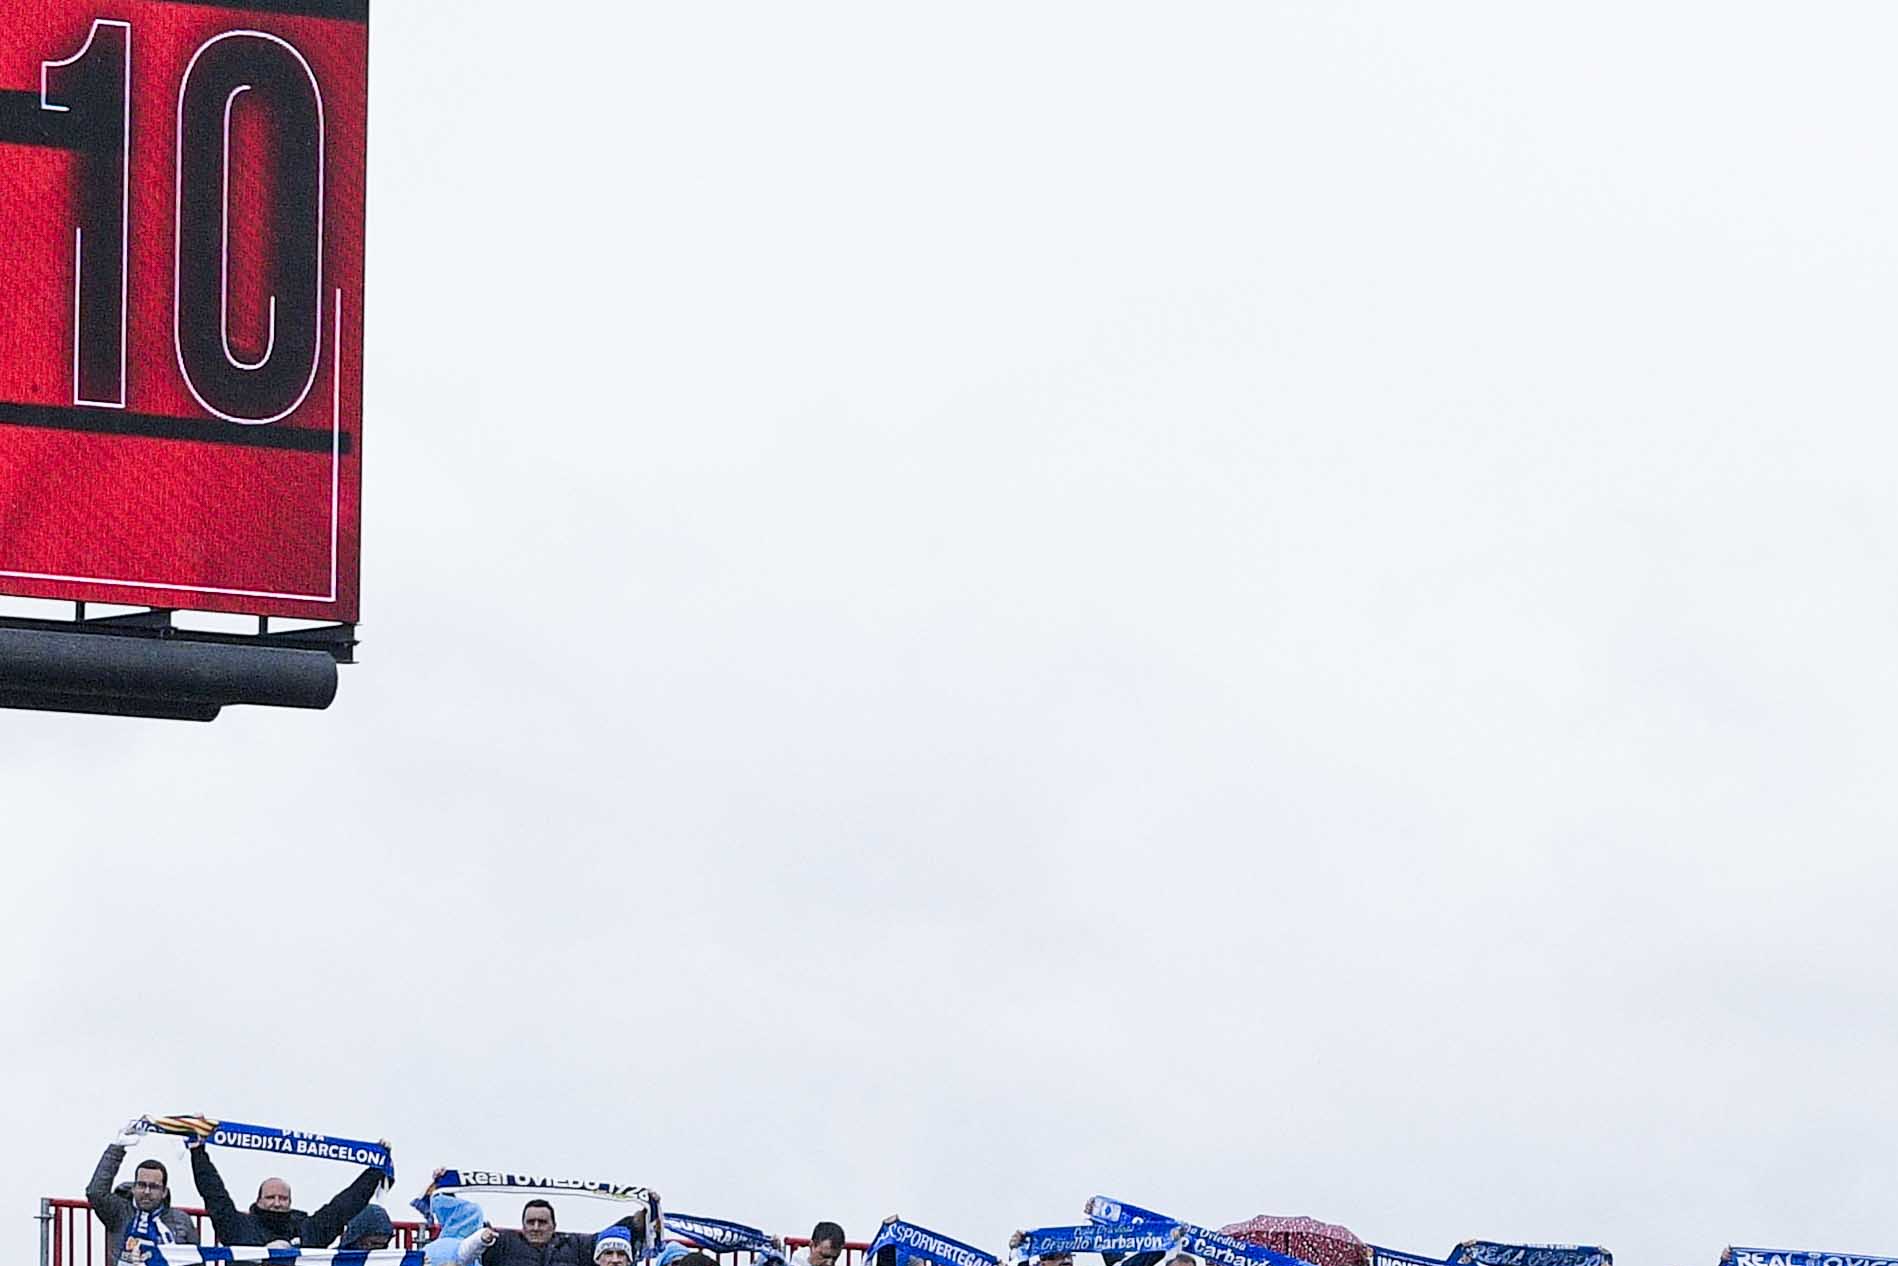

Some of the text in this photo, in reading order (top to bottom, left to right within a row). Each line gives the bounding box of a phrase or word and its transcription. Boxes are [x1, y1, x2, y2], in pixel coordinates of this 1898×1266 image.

[42, 20, 324, 425] 10
[213, 1130, 294, 1154] OVIEDISTA
[1092, 1231, 1163, 1250] Carbayón
